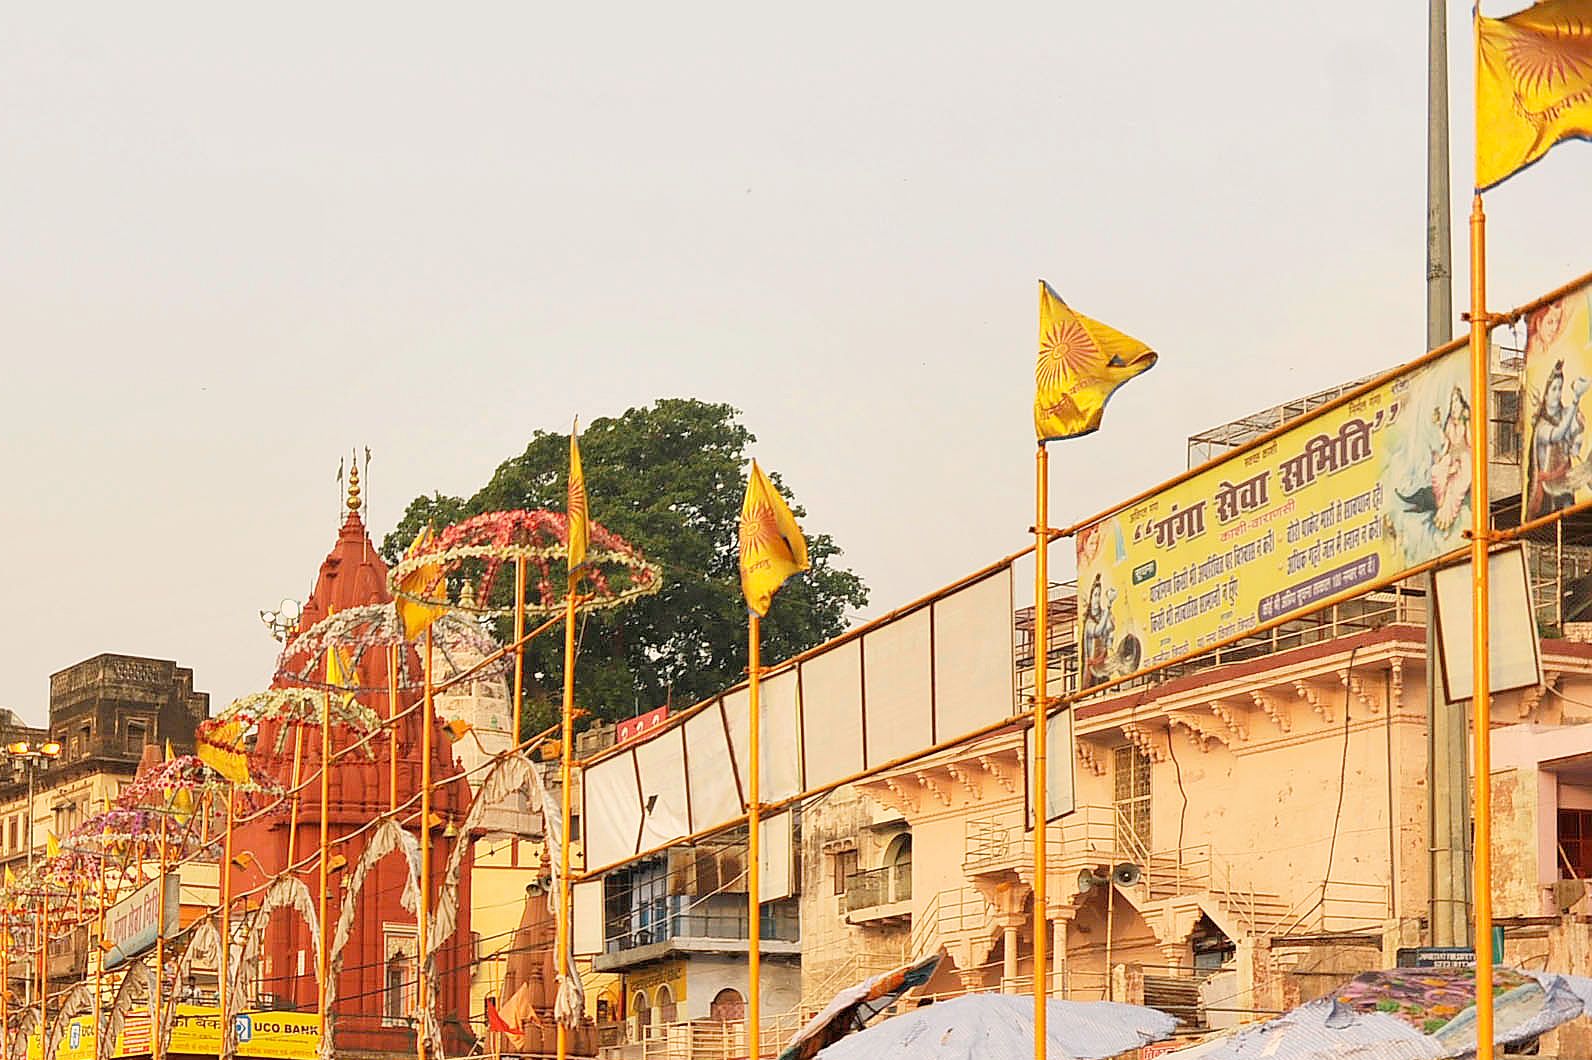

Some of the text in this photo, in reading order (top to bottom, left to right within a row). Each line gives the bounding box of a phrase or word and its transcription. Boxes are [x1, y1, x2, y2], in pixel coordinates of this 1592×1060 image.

[1214, 470, 1271, 522] सेवा
[1220, 497, 1295, 542] काशी-वाराणसी
[254, 1022, 319, 1036] UCO BANK
